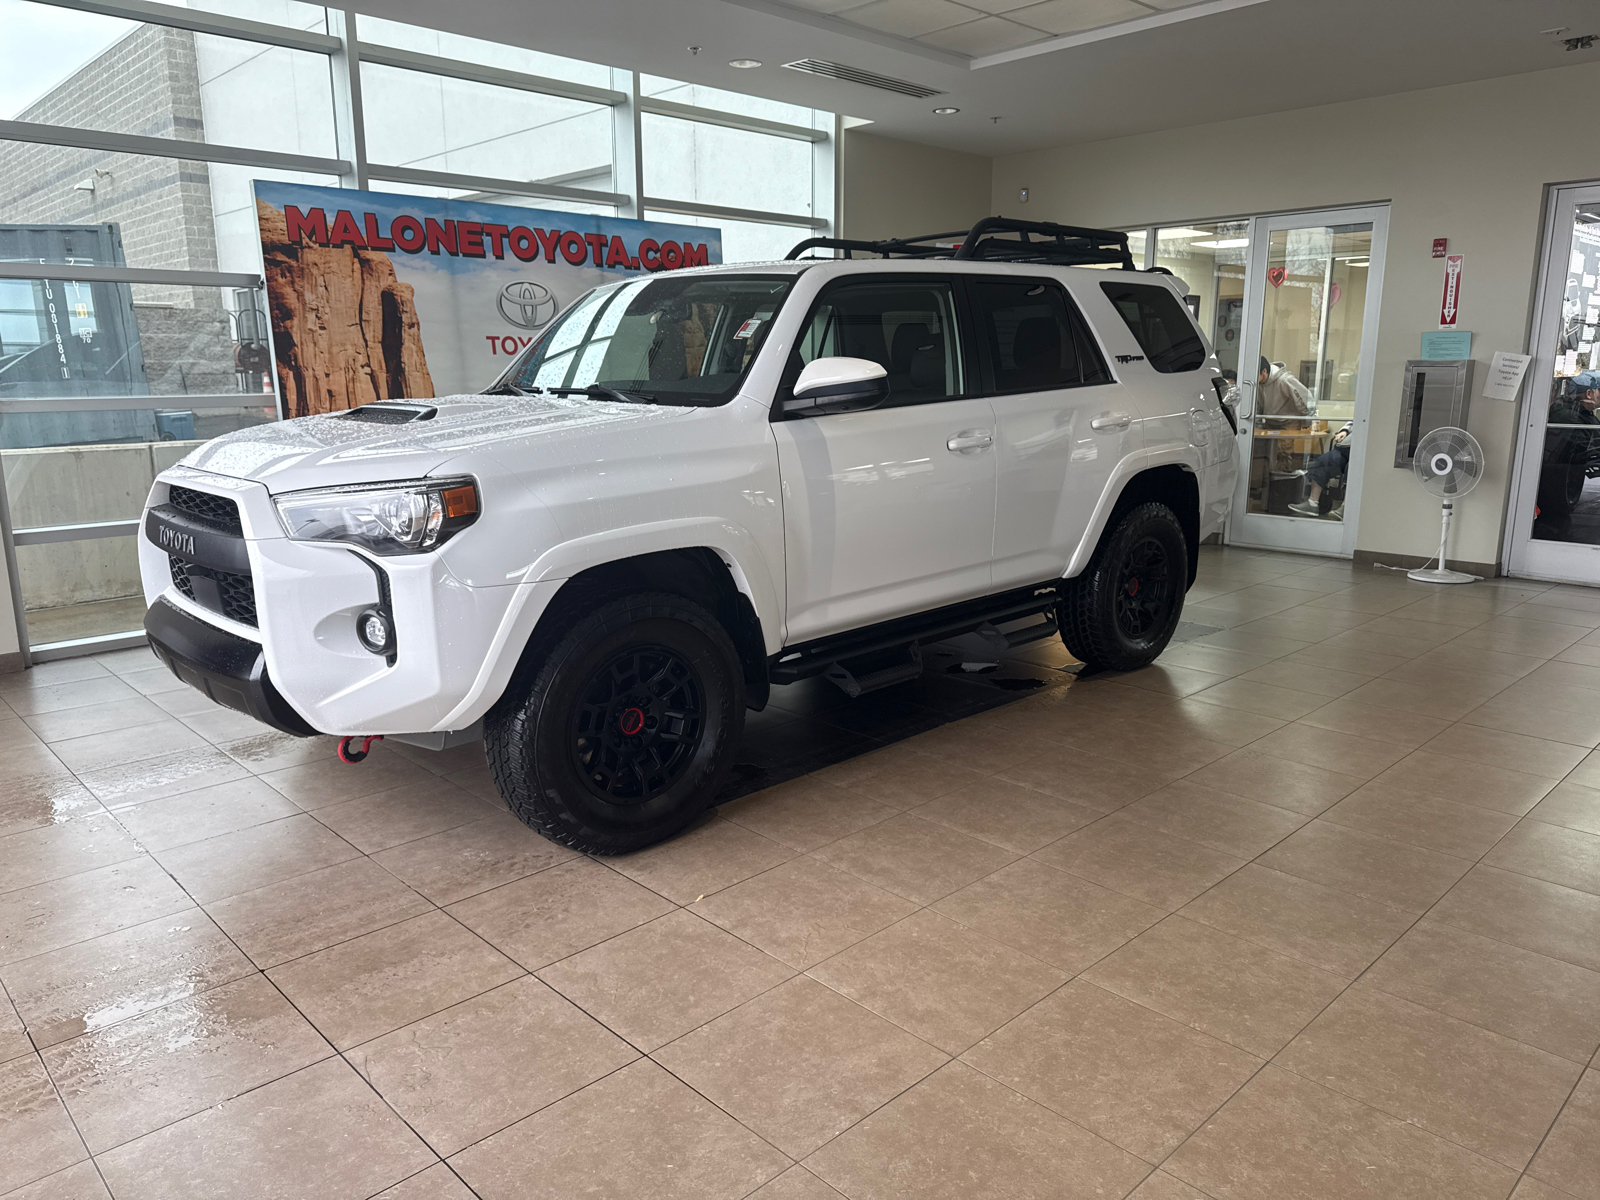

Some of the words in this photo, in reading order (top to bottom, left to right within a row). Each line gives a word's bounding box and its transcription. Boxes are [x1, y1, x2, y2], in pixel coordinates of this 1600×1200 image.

[284, 205, 708, 272] MALONETOYOTA.COM
[1447, 268, 1456, 318] EXTINGUISHER
[49, 303, 66, 364] 081884
[485, 335, 533, 356] TOY
[1115, 355, 1132, 364] TRD
[159, 524, 195, 555] TOYOTA
